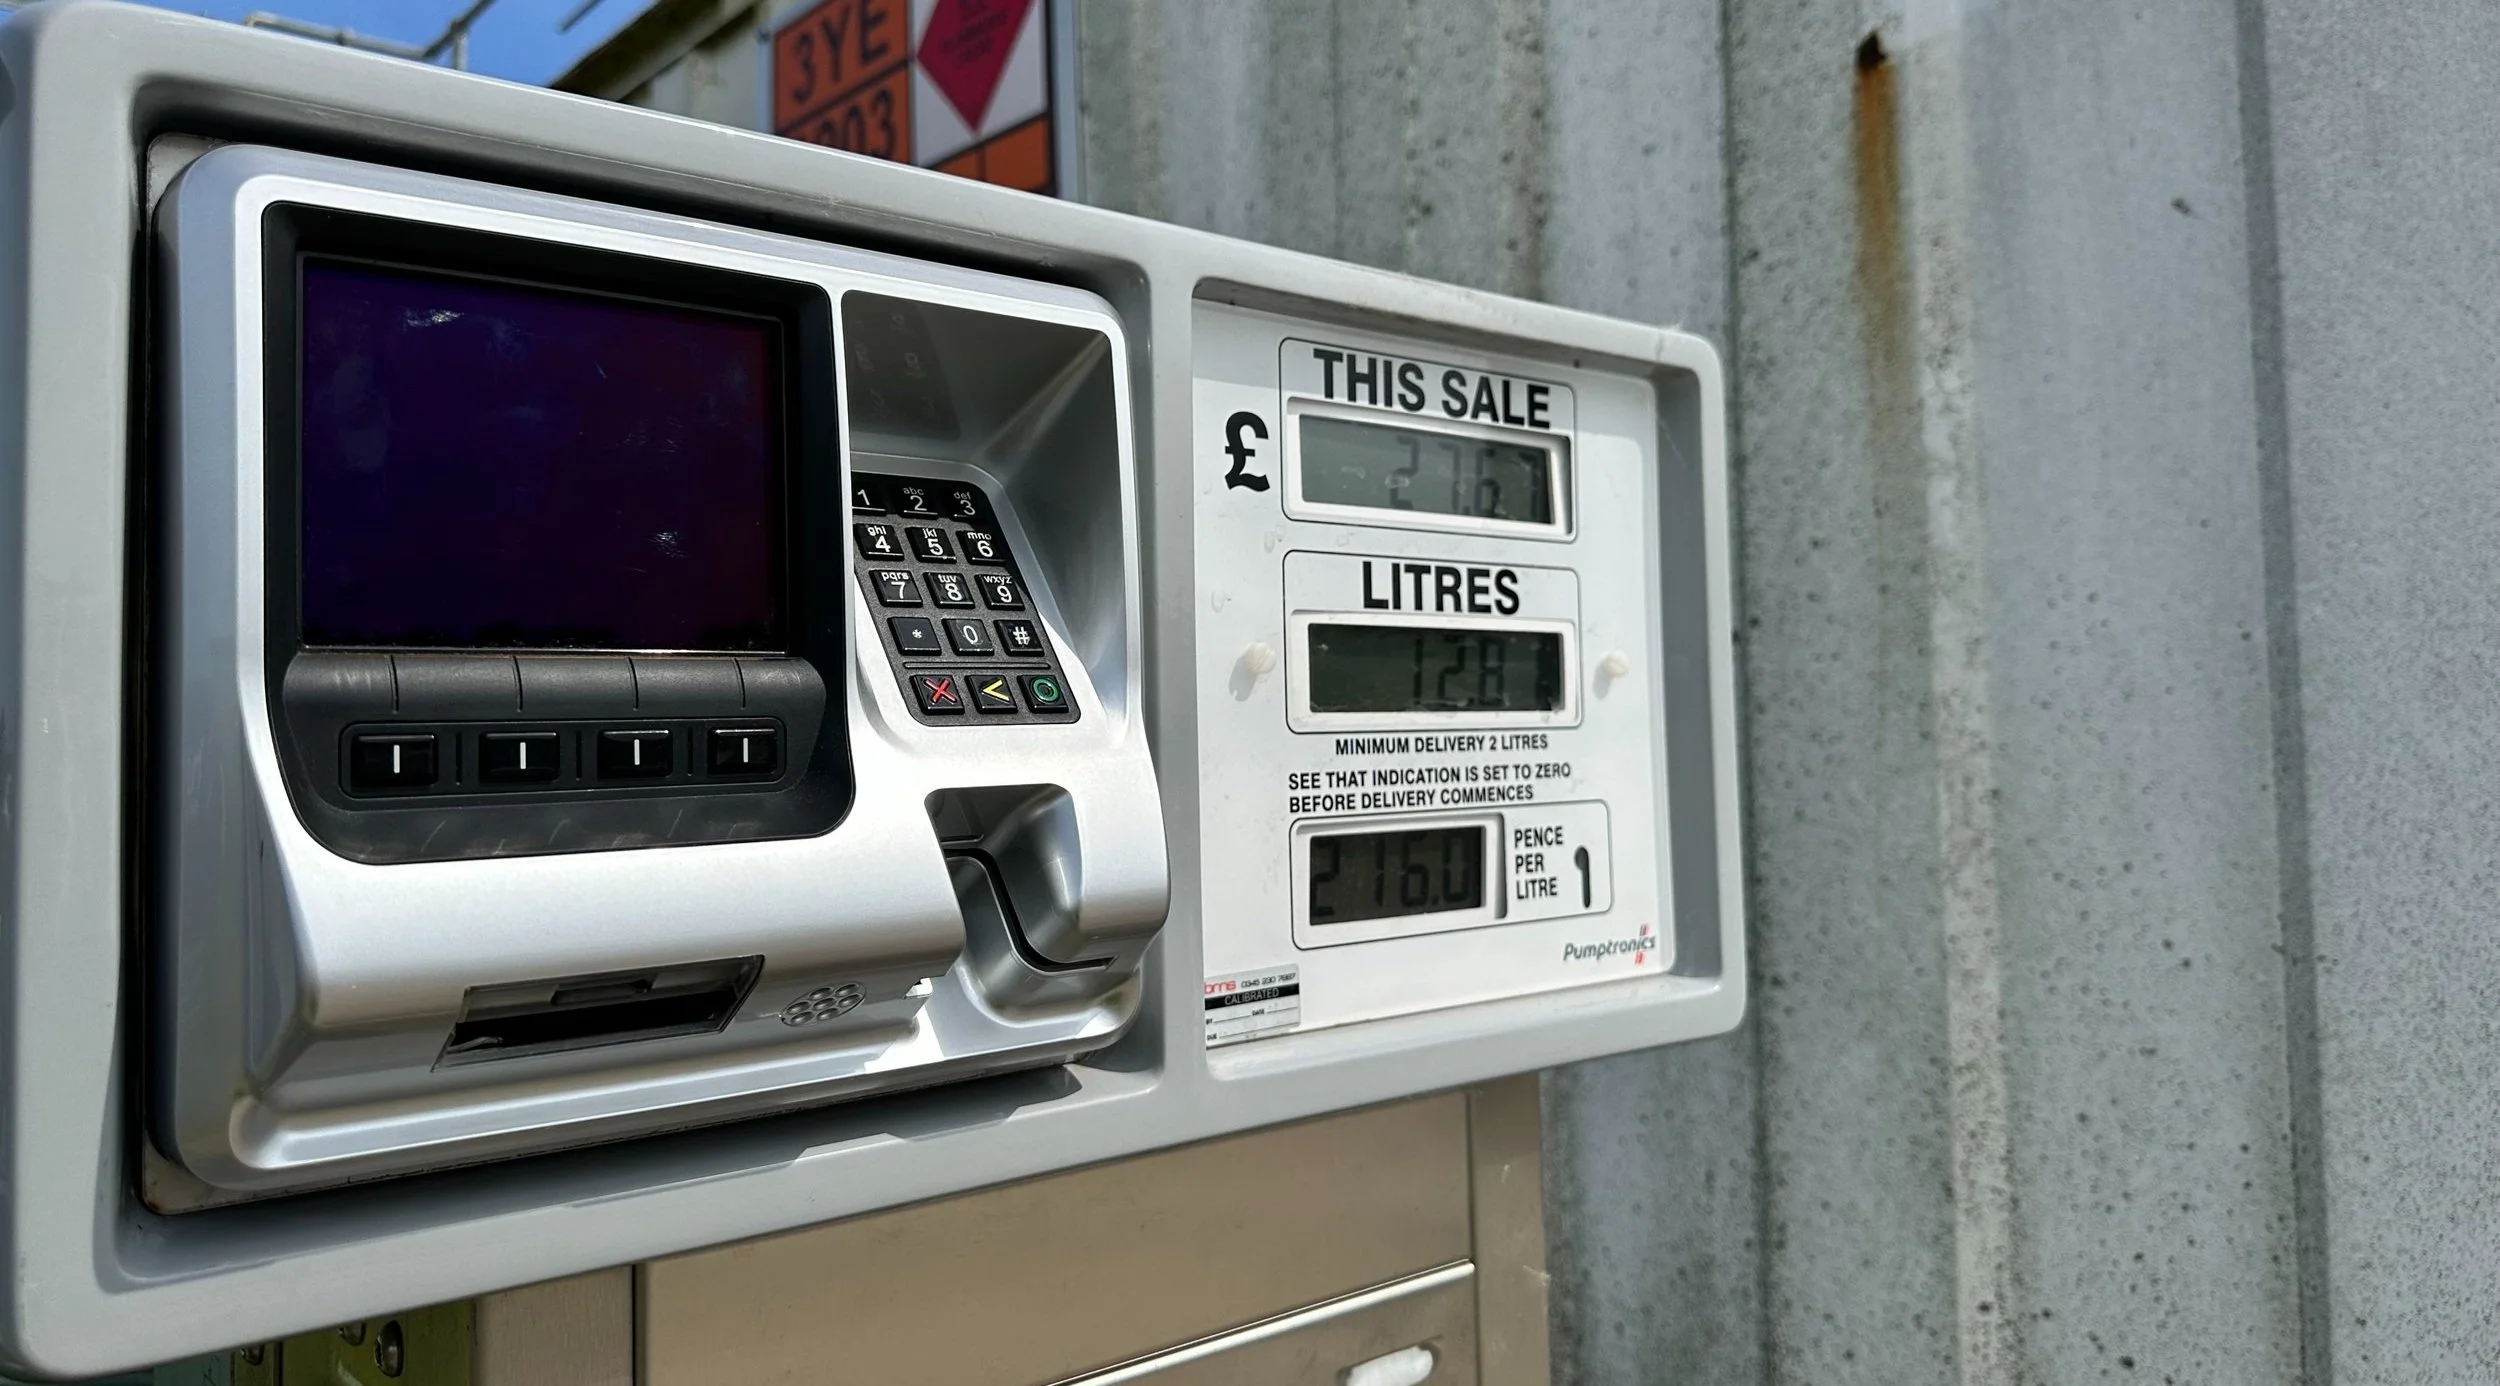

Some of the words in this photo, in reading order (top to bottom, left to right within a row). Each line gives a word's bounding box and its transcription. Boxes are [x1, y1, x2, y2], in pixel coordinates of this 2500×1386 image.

[791, 0, 890, 105] 3YE
[1313, 348, 1426, 412] THIS
[1441, 369, 1550, 429] SALE
[1224, 411, 1271, 492] £
[857, 489, 871, 506] 1
[903, 486, 925, 496] abc
[909, 495, 928, 511] 2
[959, 499, 976, 516] 3
[867, 525, 887, 536] ghi
[966, 531, 992, 541] mno
[875, 536, 891, 553] 4
[927, 538, 944, 556] 5
[976, 541, 994, 558] 6
[938, 573, 957, 584] tuv
[983, 574, 1013, 587] wxyz
[890, 581, 906, 600] 7
[944, 583, 963, 601] 8
[996, 586, 1013, 603] 9
[1362, 560, 1521, 616] LITRES
[962, 625, 979, 645] 0
[1012, 626, 1030, 646] #
[1335, 737, 1410, 755] MINIMUM
[1414, 735, 1485, 753] DELIVERY
[1489, 736, 1497, 750] 2
[1501, 733, 1548, 750] LITRES
[1288, 772, 1321, 790] SEE
[1325, 770, 1367, 788] THAT
[1372, 766, 1460, 786] INDICATION
[1465, 766, 1479, 782] IS
[1483, 764, 1509, 781] SET
[1512, 763, 1532, 779] TO
[1535, 762, 1571, 778] ZERO
[1289, 793, 1356, 813] BEFORE
[1361, 789, 1436, 810] DELIVERY
[1440, 784, 1534, 804] COMMENCES
[1514, 826, 1564, 848] PENCE
[1516, 854, 1544, 873] PER
[1516, 877, 1558, 899] LITRE
[1563, 936, 1656, 962] Pumptronics
[1224, 988, 1279, 1005] CALIBRATED
